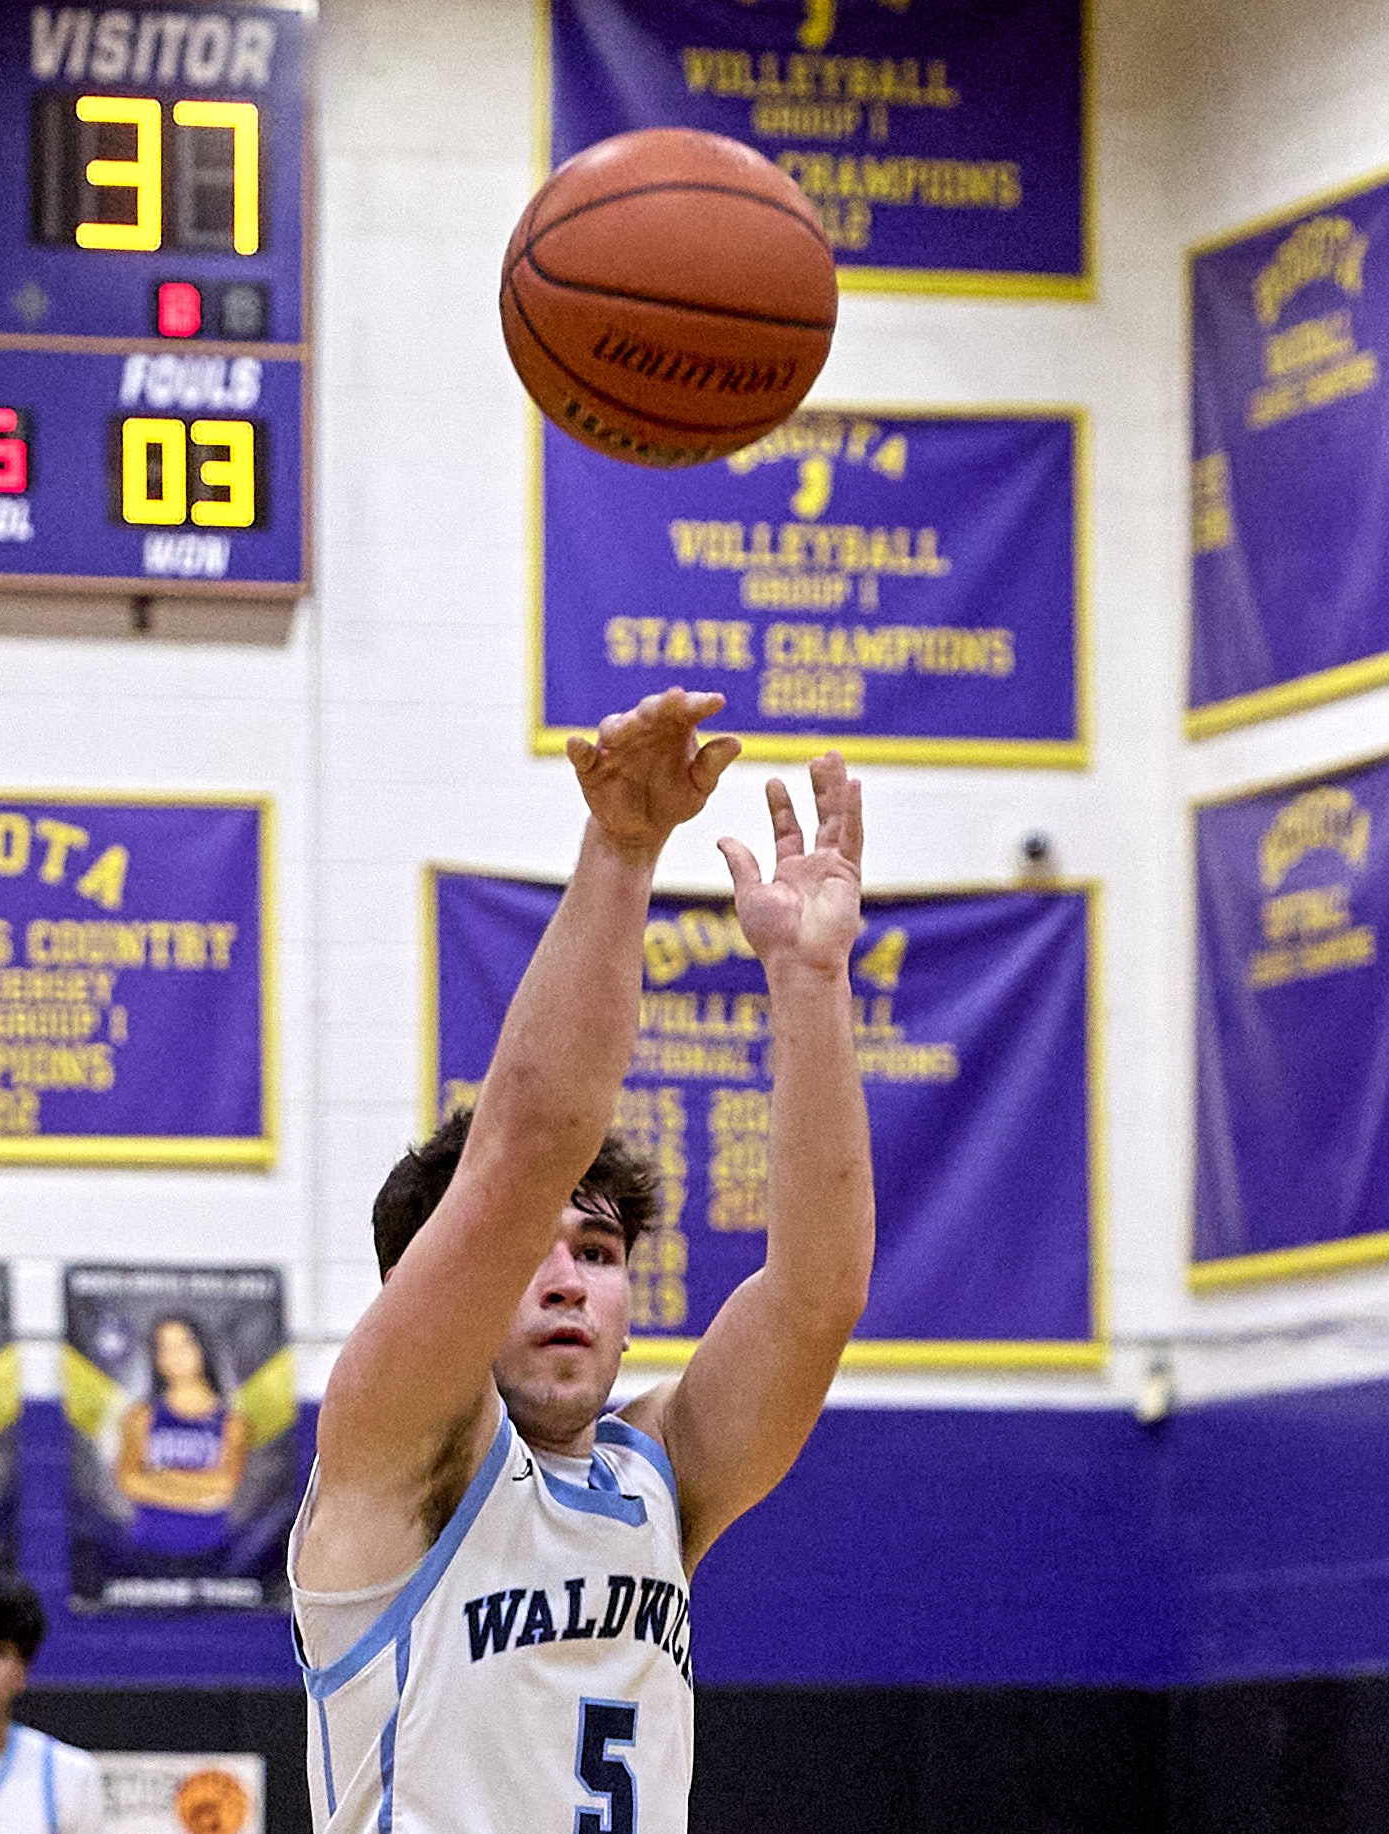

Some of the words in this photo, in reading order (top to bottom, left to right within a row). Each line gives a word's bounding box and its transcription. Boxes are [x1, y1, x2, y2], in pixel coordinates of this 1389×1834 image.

[29, 8, 276, 85] VISITOR
[681, 47, 960, 108] VOLLEYBALL
[75, 96, 260, 256] 37
[118, 355, 264, 410] FOULS
[122, 417, 256, 528] 03
[669, 518, 952, 578] VOLLEYBALL
[604, 615, 756, 671] STATE
[763, 621, 1017, 678] CHAMPIONS
[25, 918, 238, 971] COUNTRY
[463, 1574, 691, 1690] WALDWIC
